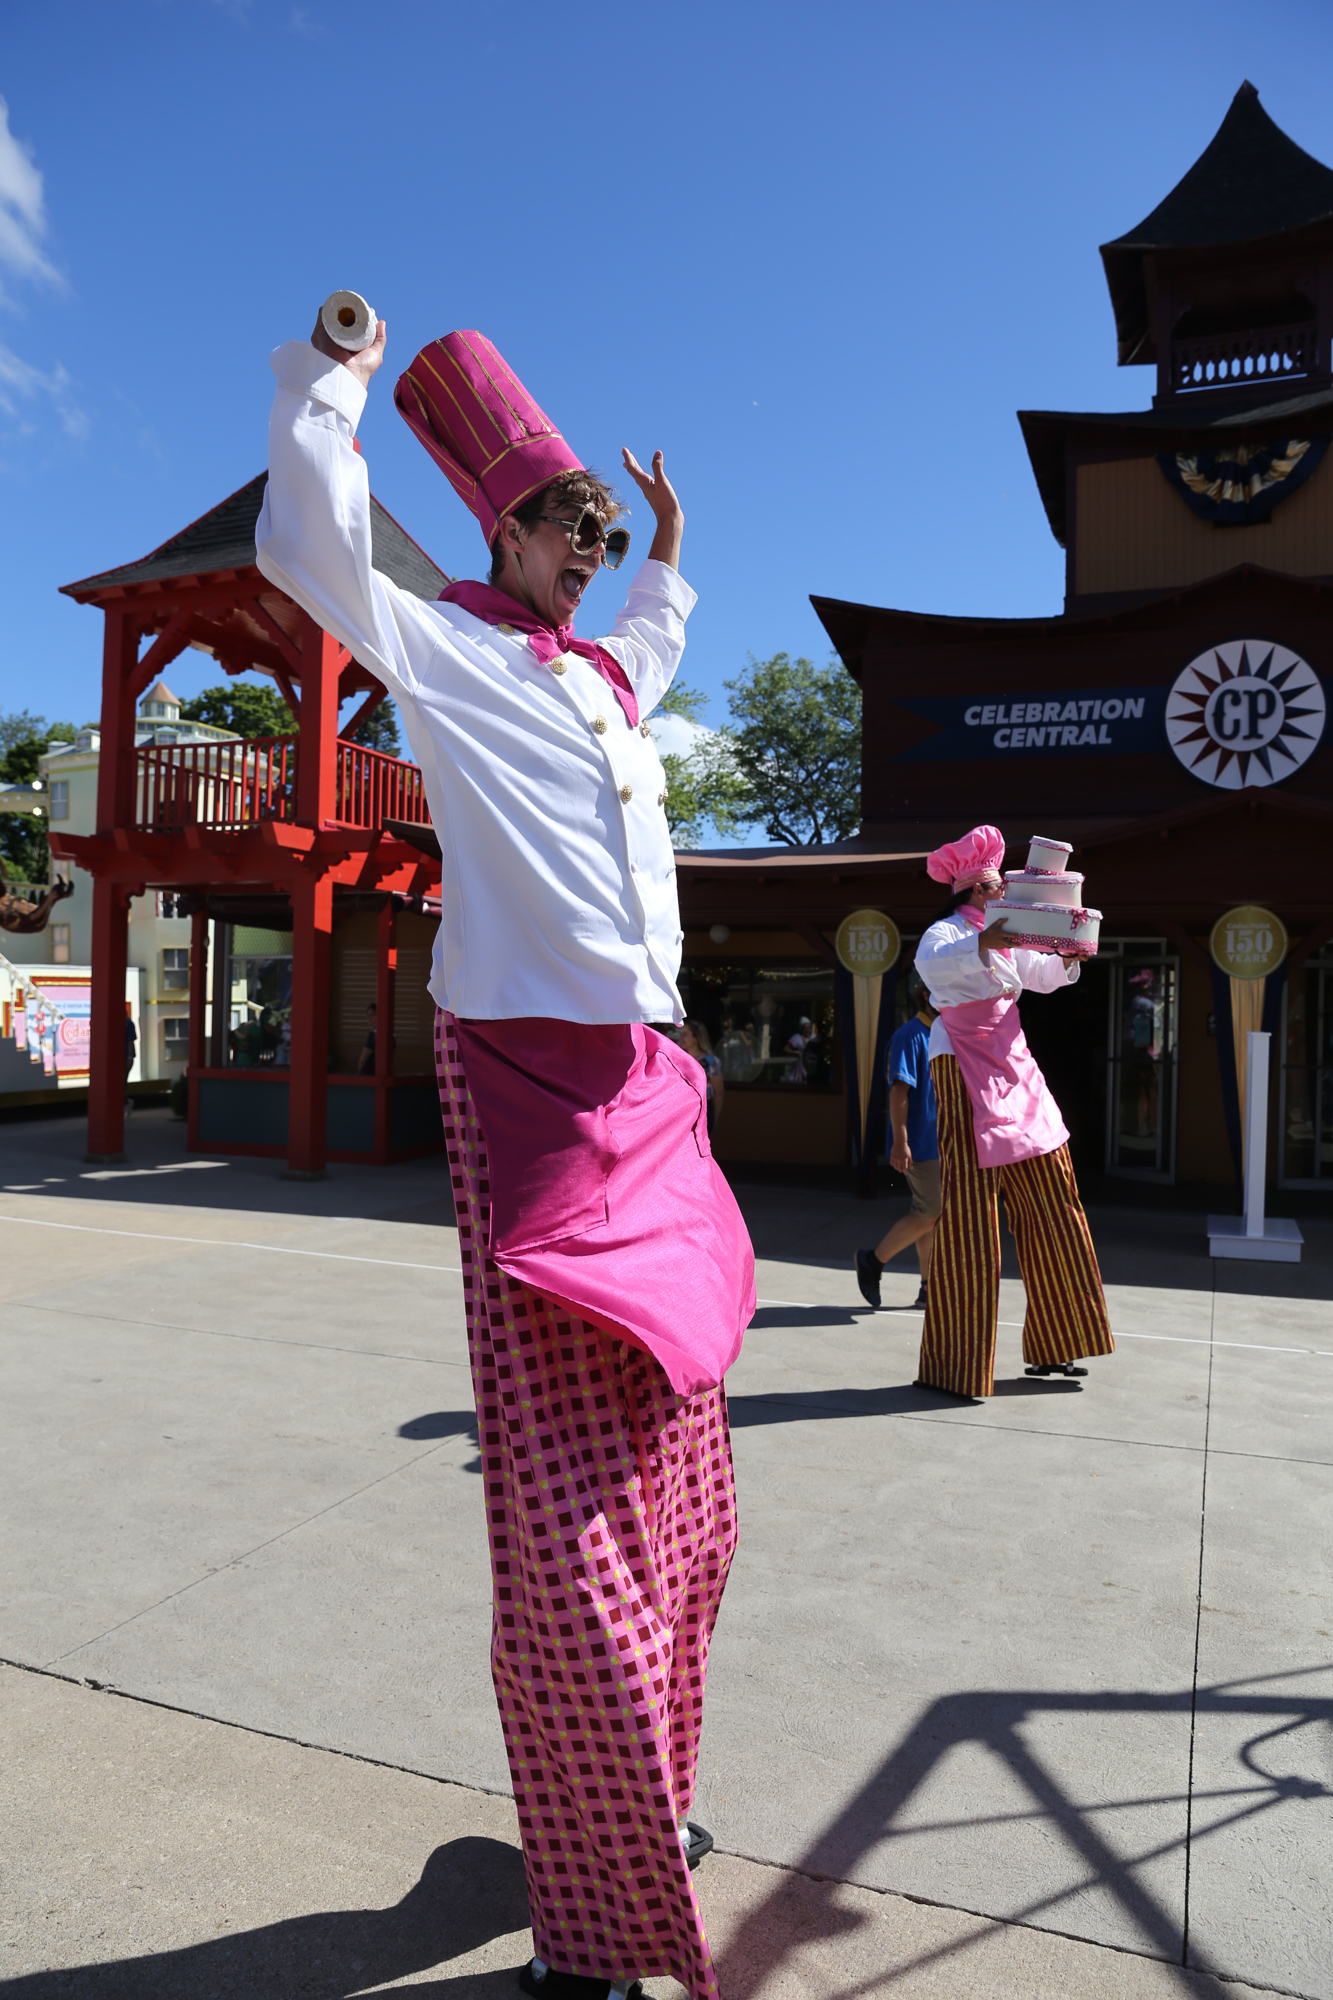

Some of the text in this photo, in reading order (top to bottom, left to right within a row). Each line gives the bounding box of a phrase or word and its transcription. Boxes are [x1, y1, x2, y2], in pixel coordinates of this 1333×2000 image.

[964, 697, 1145, 726] CELEBRATION
[1212, 688, 1277, 741] CP
[993, 724, 1112, 749] CENTRAL
[847, 931, 889, 953] 150
[1224, 930, 1274, 954] 150
[850, 953, 884, 961] YEARS
[1227, 953, 1268, 963] YEARS
